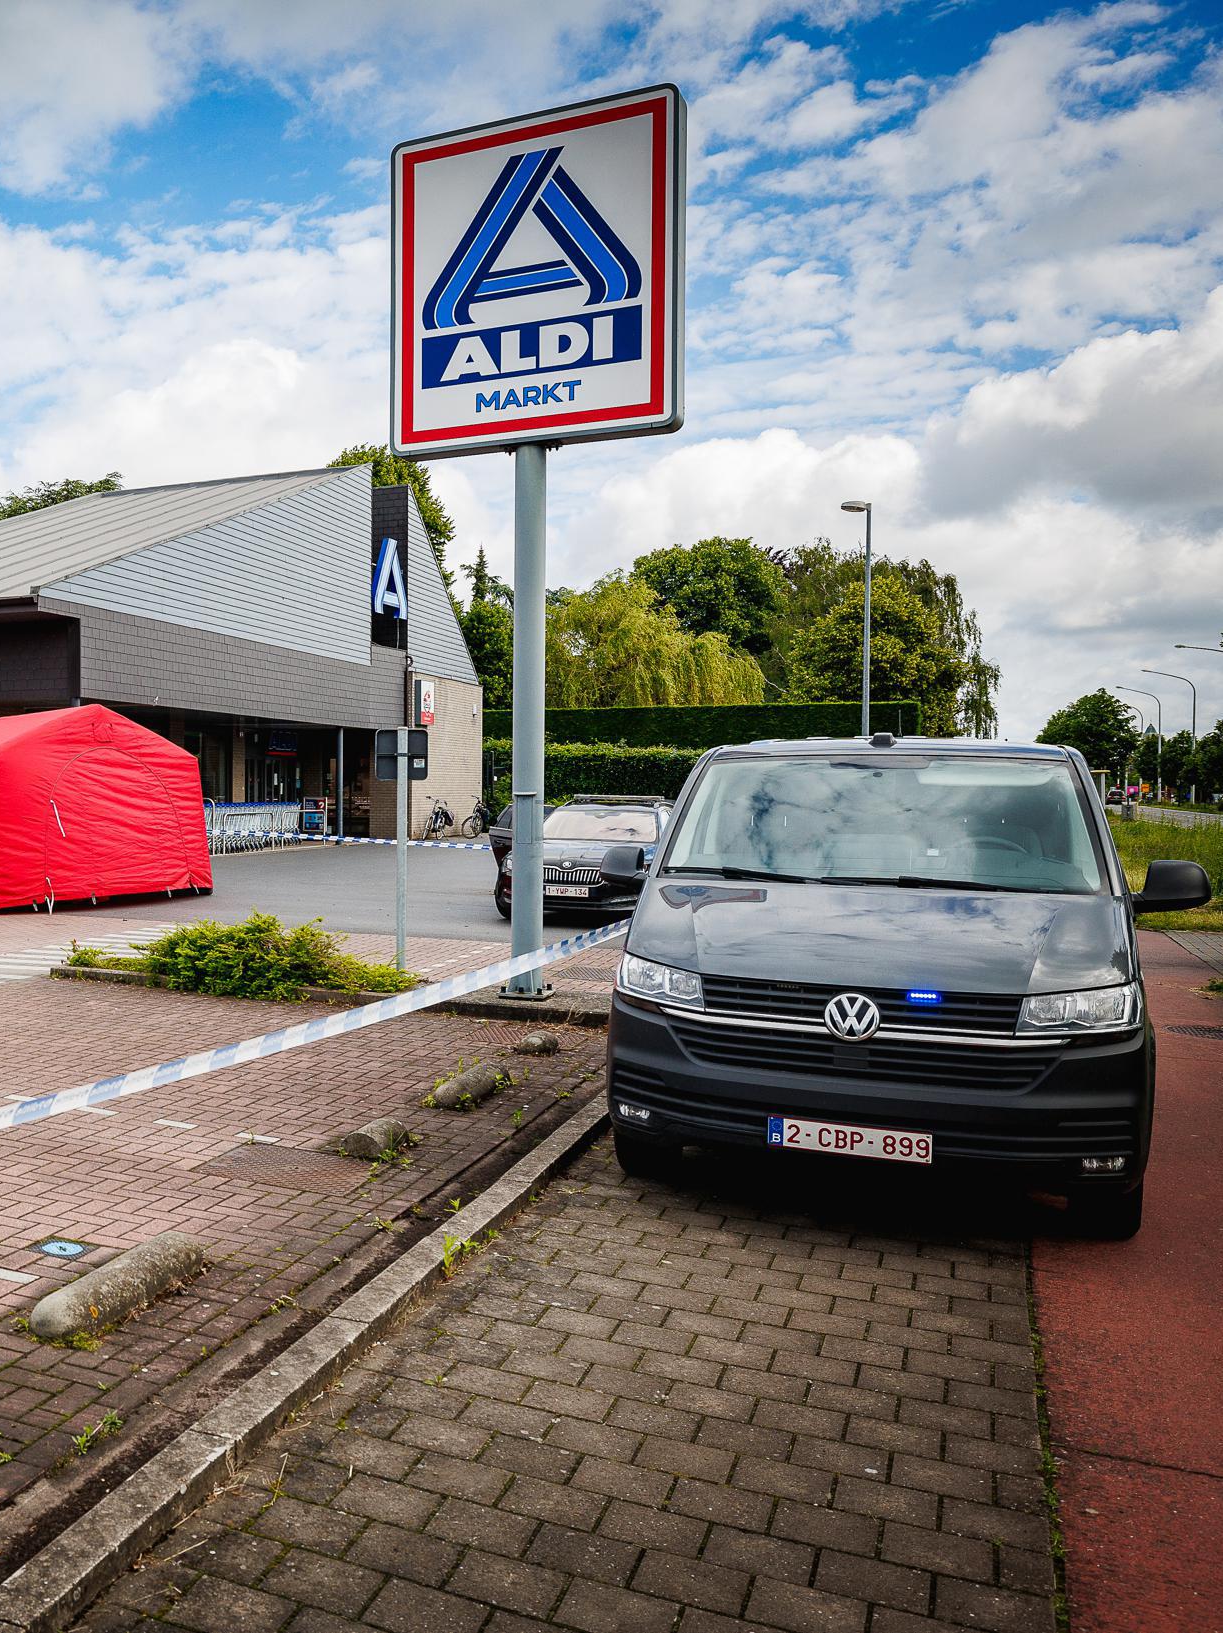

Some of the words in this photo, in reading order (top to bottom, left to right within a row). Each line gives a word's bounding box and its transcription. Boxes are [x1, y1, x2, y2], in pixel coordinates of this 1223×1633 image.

[439, 315, 614, 382] ALDI
[475, 380, 581, 412] MARKT
[772, 1133, 781, 1143] B
